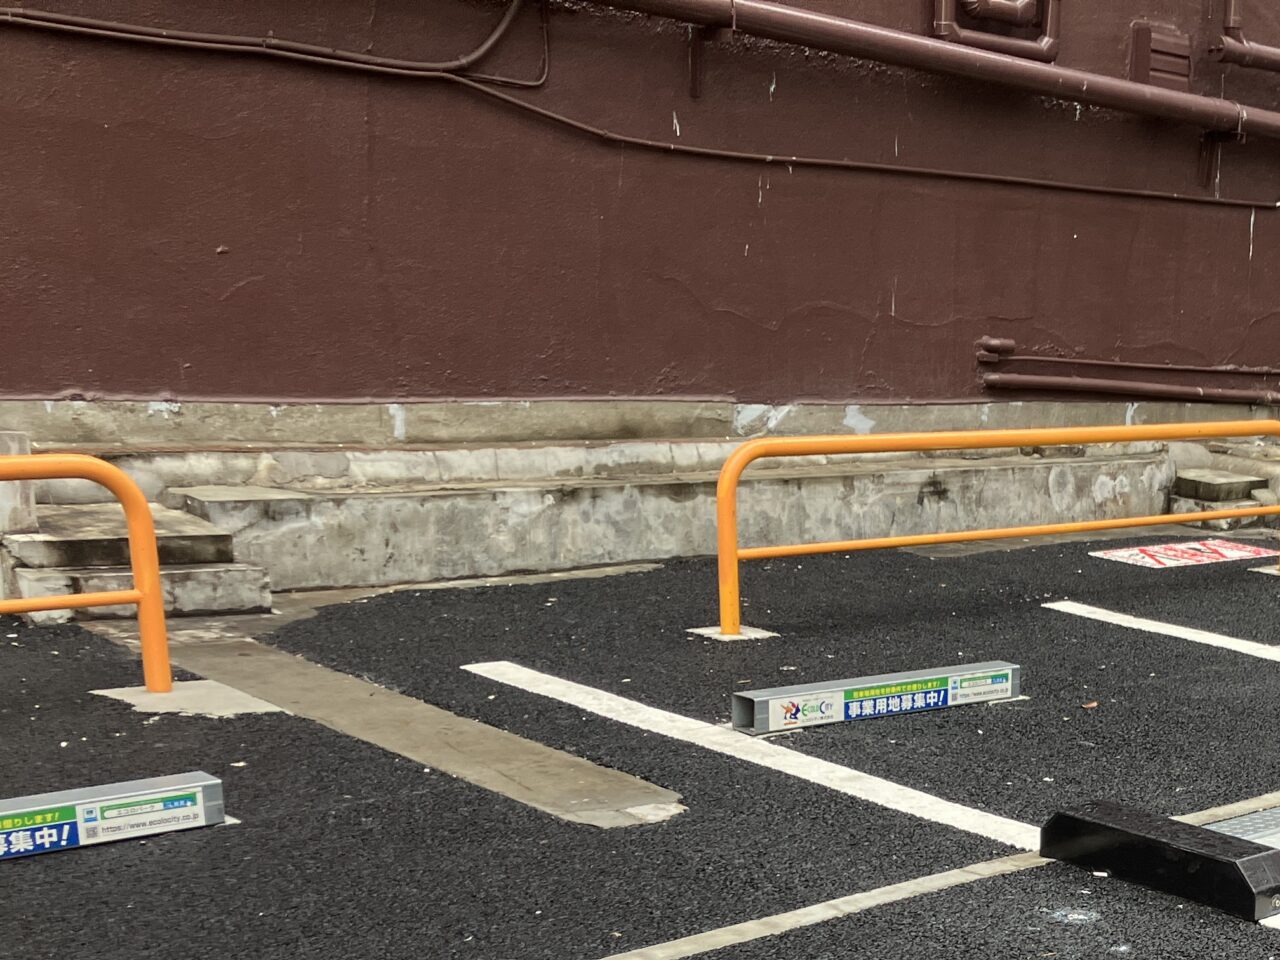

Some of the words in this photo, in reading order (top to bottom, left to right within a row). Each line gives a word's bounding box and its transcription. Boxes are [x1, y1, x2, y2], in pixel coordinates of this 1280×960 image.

[848, 690, 945, 718] 事業用地募集中!
